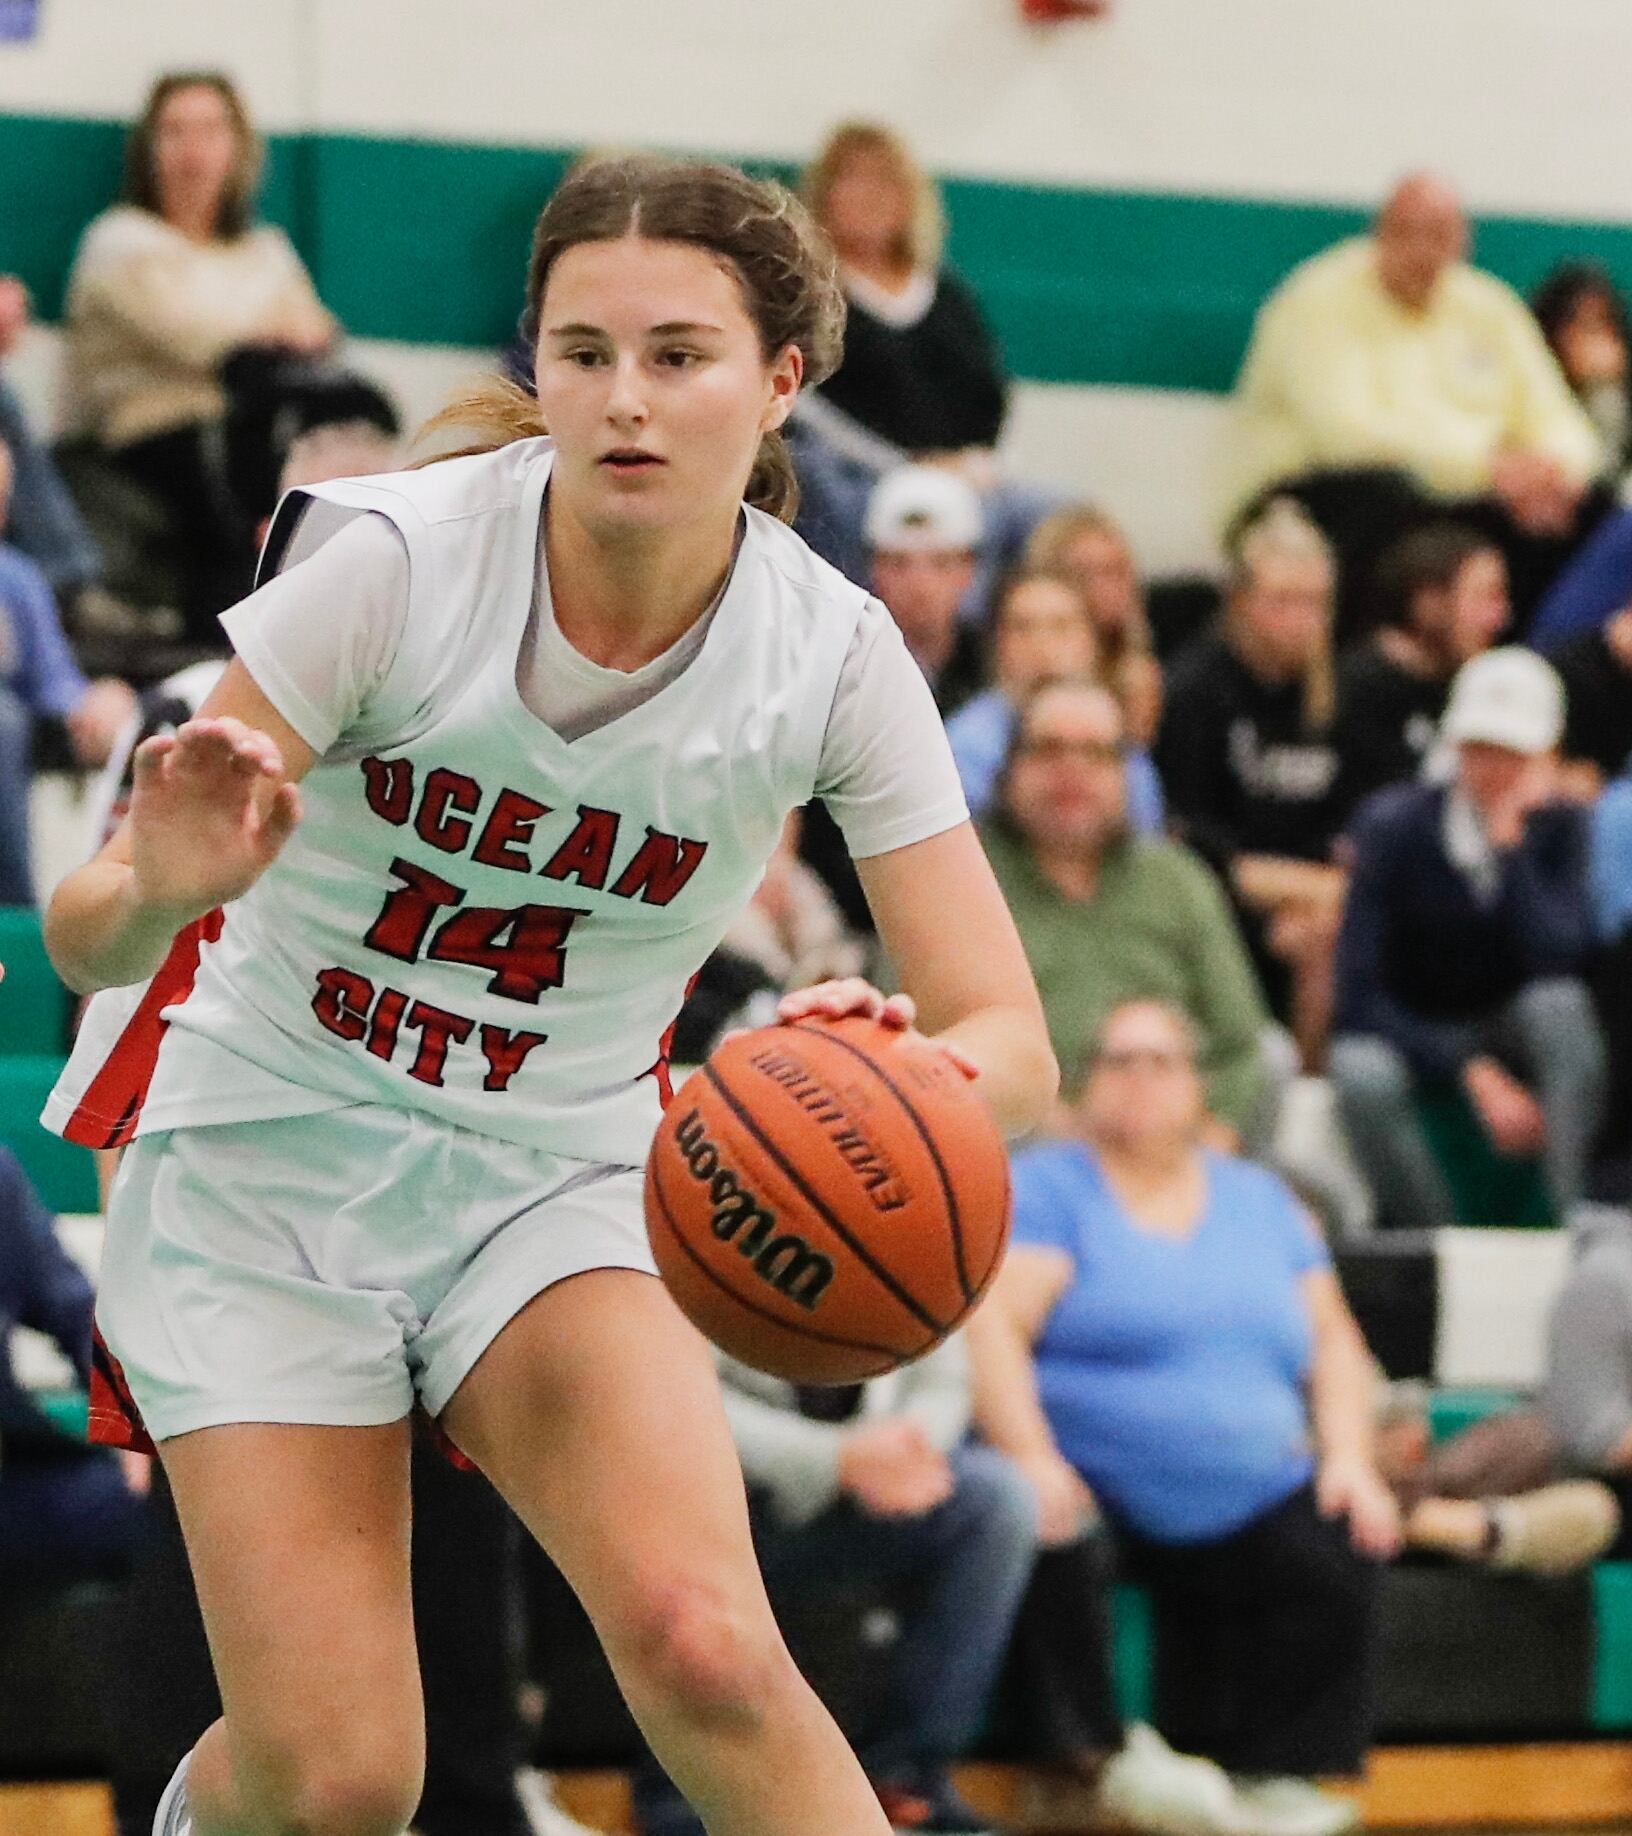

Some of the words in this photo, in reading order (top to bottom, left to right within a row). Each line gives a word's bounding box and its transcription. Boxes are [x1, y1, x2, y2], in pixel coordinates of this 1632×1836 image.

[360, 756, 708, 906] OCEAN
[363, 857, 592, 1005] 14
[311, 967, 548, 1091] CITY
[674, 1107, 835, 1312] Wilson
